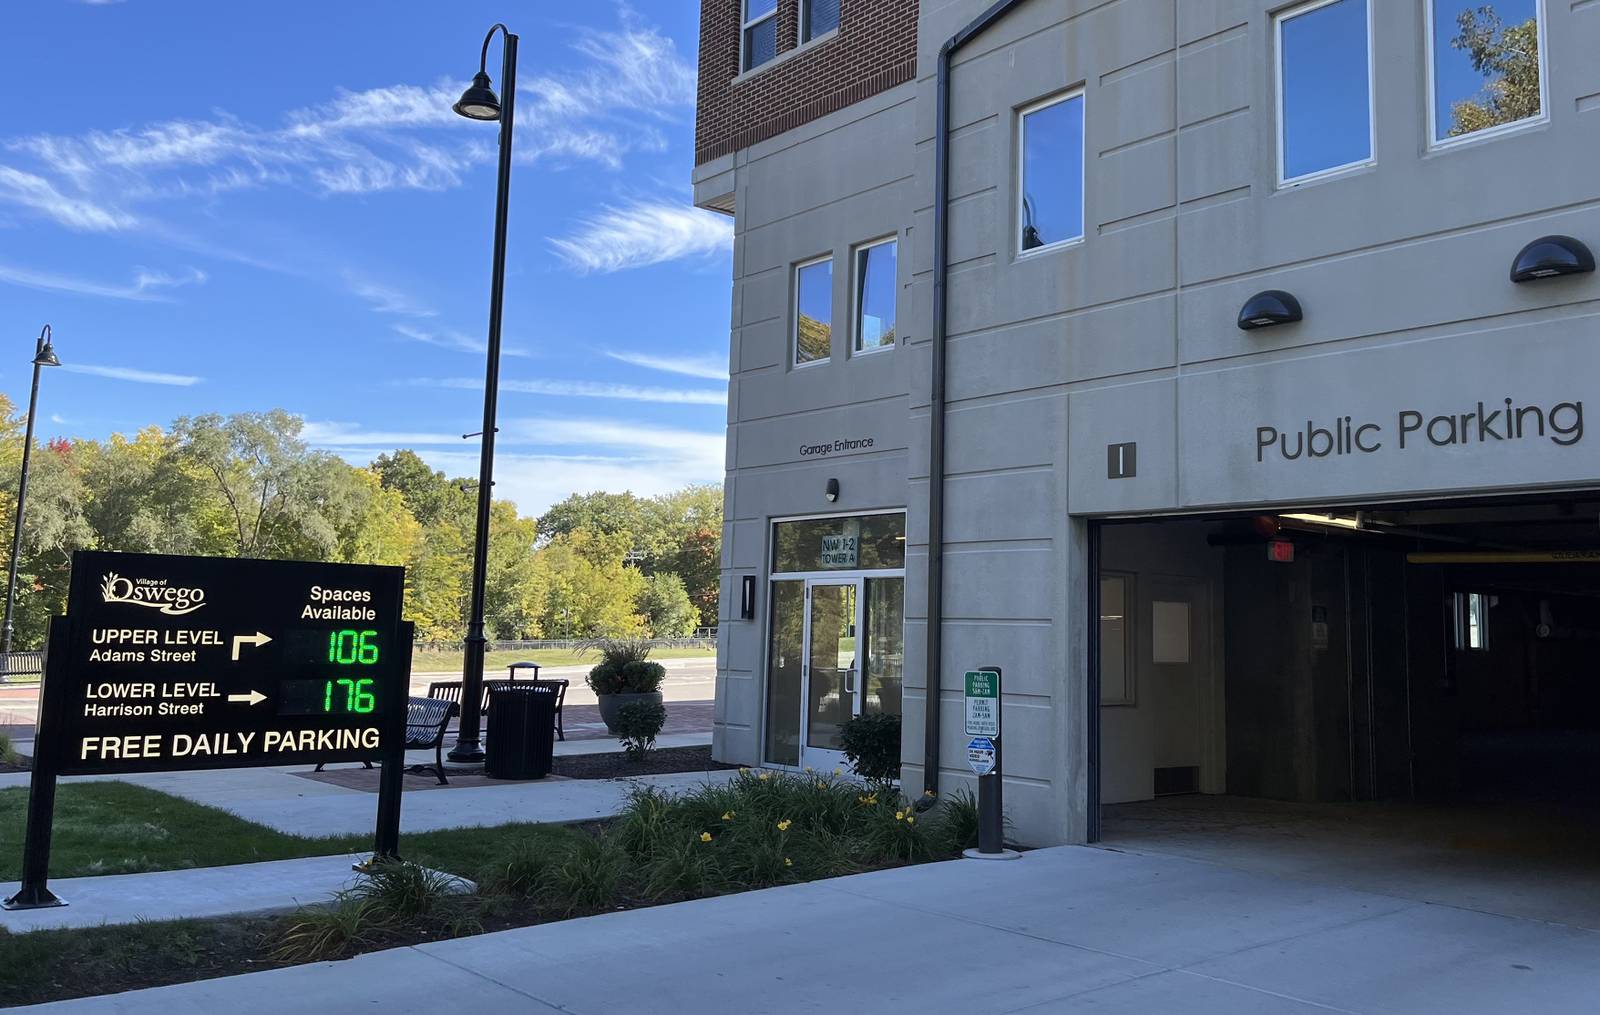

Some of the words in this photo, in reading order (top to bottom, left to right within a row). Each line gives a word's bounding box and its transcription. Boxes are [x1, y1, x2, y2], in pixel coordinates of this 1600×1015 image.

[1256, 415, 1382, 462] Public
[1399, 397, 1584, 448] Parking
[799, 443, 833, 456] Garage
[834, 438, 874, 451] Entrance
[822, 539, 839, 551] NW
[842, 537, 855, 551] 1-2
[822, 553, 847, 564] TOWER
[849, 553, 855, 562] A
[135, 578, 158, 587] Village
[109, 577, 205, 609] Oswego
[310, 585, 371, 603] Spaces
[301, 605, 376, 621] Available
[92, 629, 159, 645] UPPER
[164, 630, 224, 645] LEVEL
[89, 649, 145, 662] Adams
[150, 649, 197, 662] Street
[328, 630, 380, 665] 106
[86, 683, 156, 699] LOWER
[162, 682, 221, 698] LEVEL
[324, 679, 375, 713] 176
[84, 703, 153, 717] Harrison
[158, 702, 204, 716] Street
[80, 734, 162, 760] FREE
[172, 731, 255, 757] DAILY
[263, 727, 380, 753] PARKING
